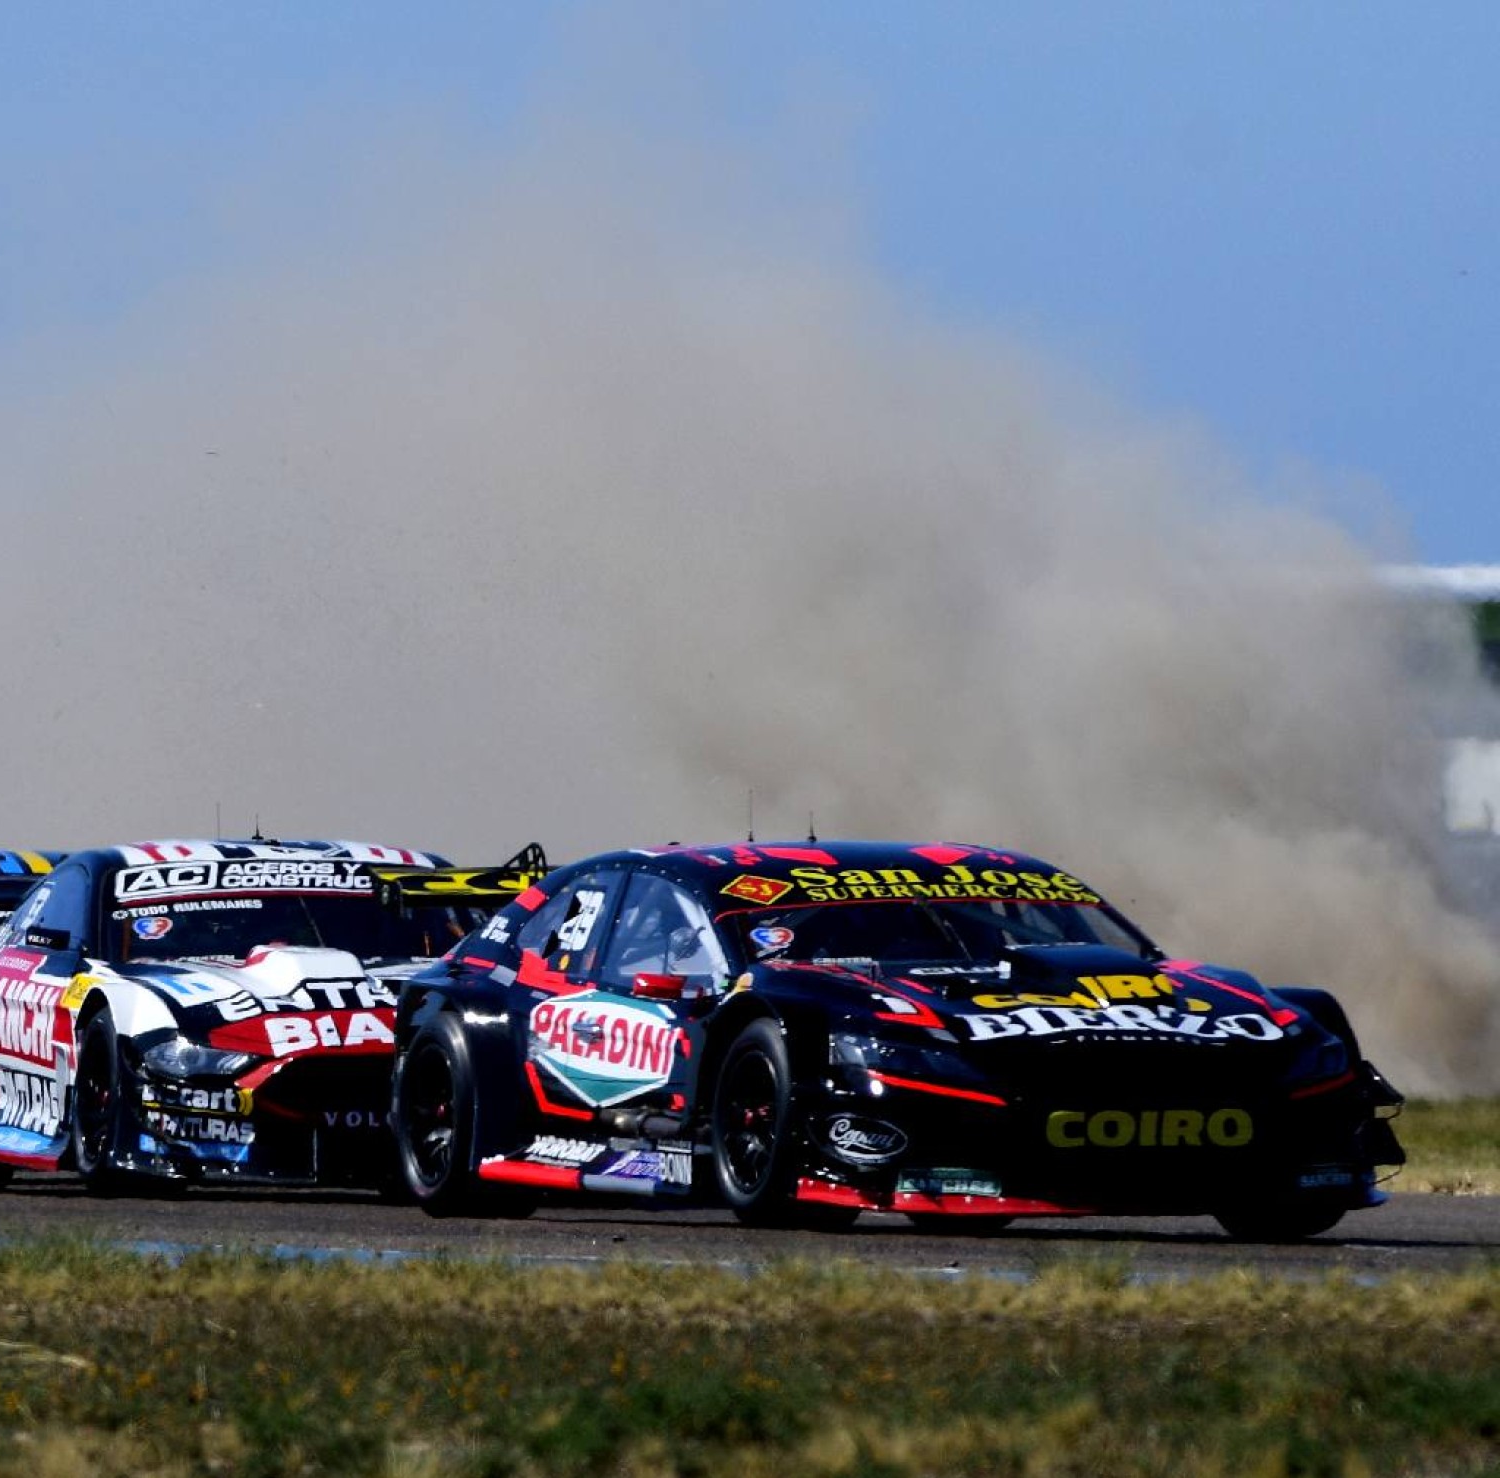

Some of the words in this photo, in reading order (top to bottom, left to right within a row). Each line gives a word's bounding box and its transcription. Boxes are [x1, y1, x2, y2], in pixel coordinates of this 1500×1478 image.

[127, 864, 204, 893] AC
[222, 862, 335, 876] ACEROS
[340, 863, 362, 875] Y
[790, 866, 925, 888] San
[942, 864, 1085, 892] José
[806, 883, 1101, 904] SUPERMERCADOS
[264, 1012, 397, 1058] BIA
[955, 1003, 1285, 1041] BIERZO
[534, 1003, 675, 1076] PALADINI
[1046, 1108, 1254, 1148] COIRO
